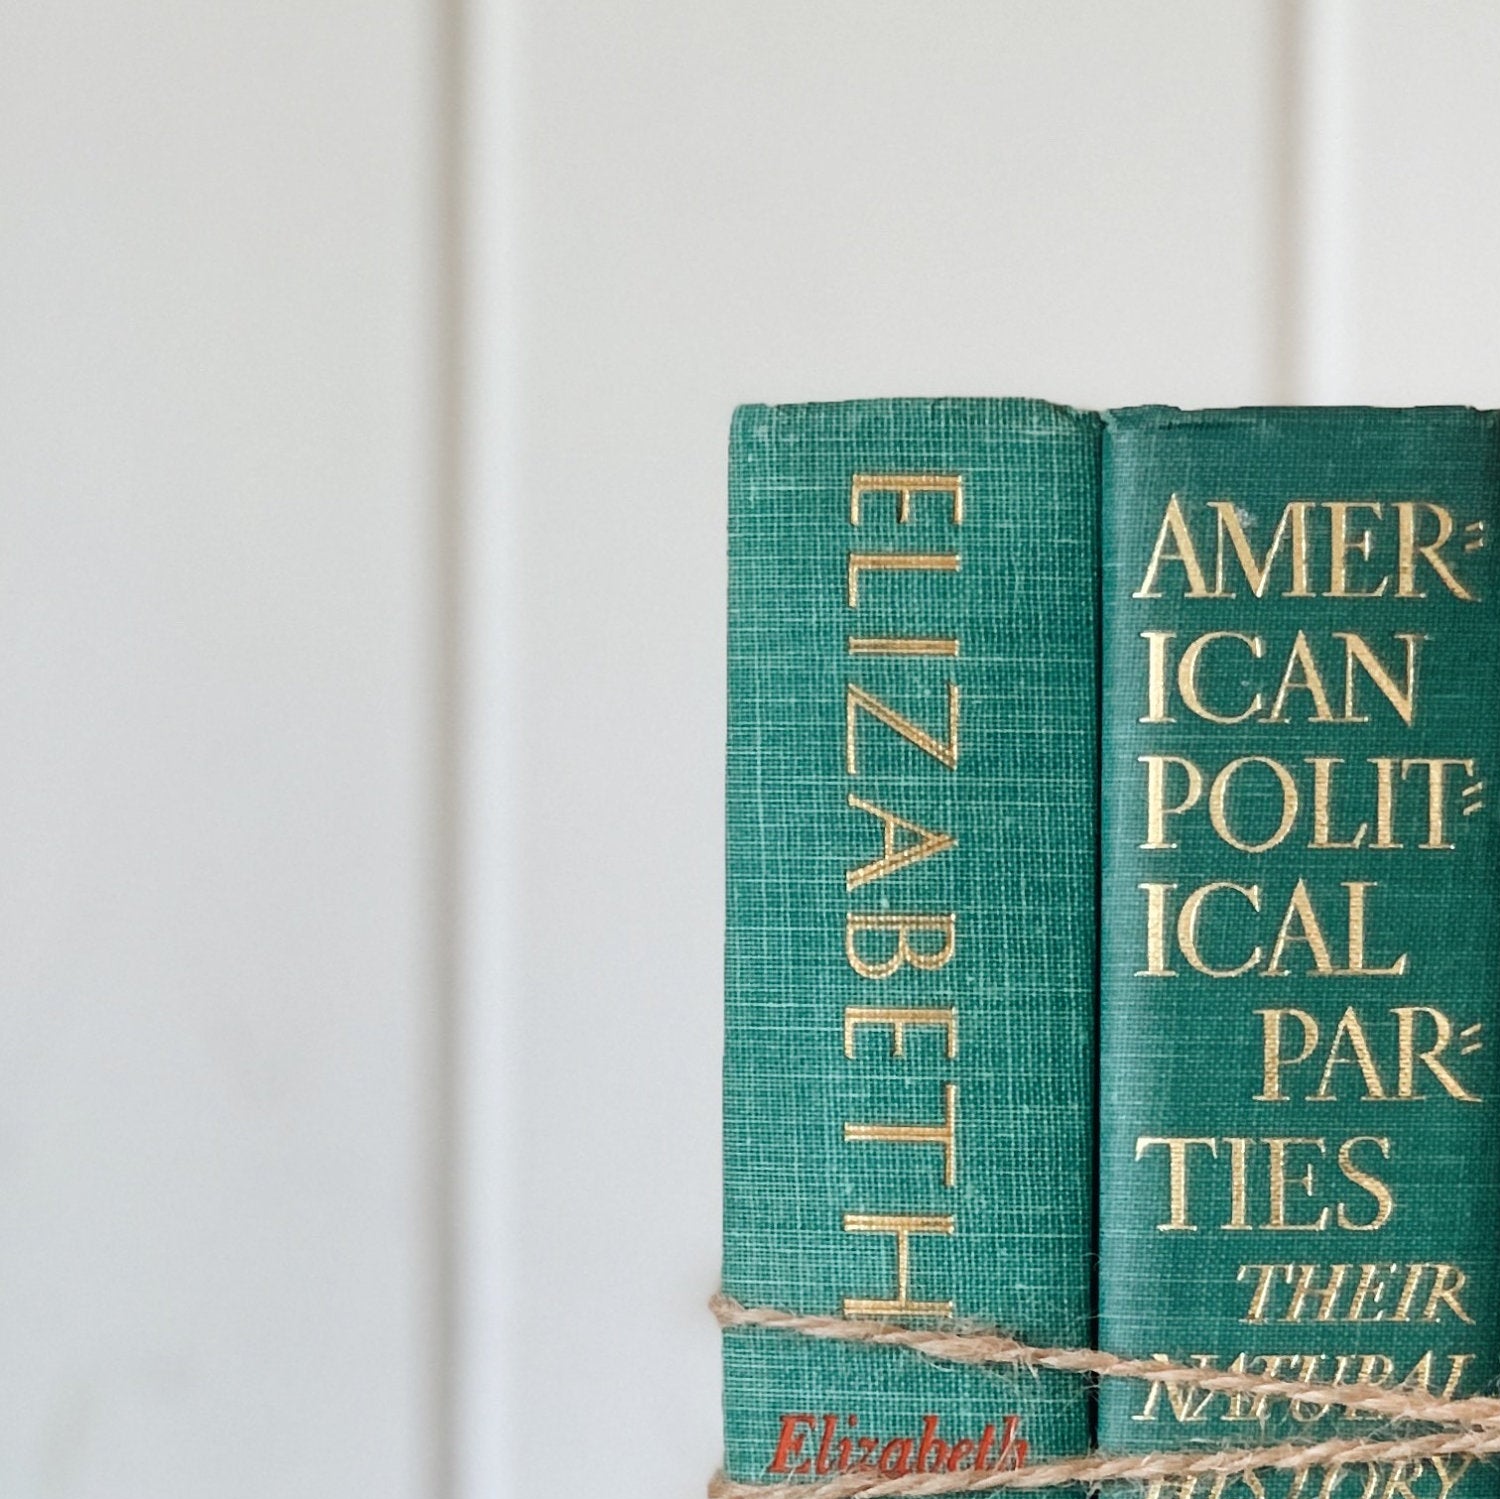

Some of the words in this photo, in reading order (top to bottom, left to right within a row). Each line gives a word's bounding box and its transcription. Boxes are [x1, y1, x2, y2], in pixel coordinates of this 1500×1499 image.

[1136, 629, 1425, 729] ICAN
[843, 473, 963, 1319] ELIZABETH
[1136, 878, 1406, 978] ICAL
[1133, 1135, 1395, 1233] TIES
[1236, 1262, 1477, 1326] THEIR
[767, 1412, 1031, 1478] Elizabeth
